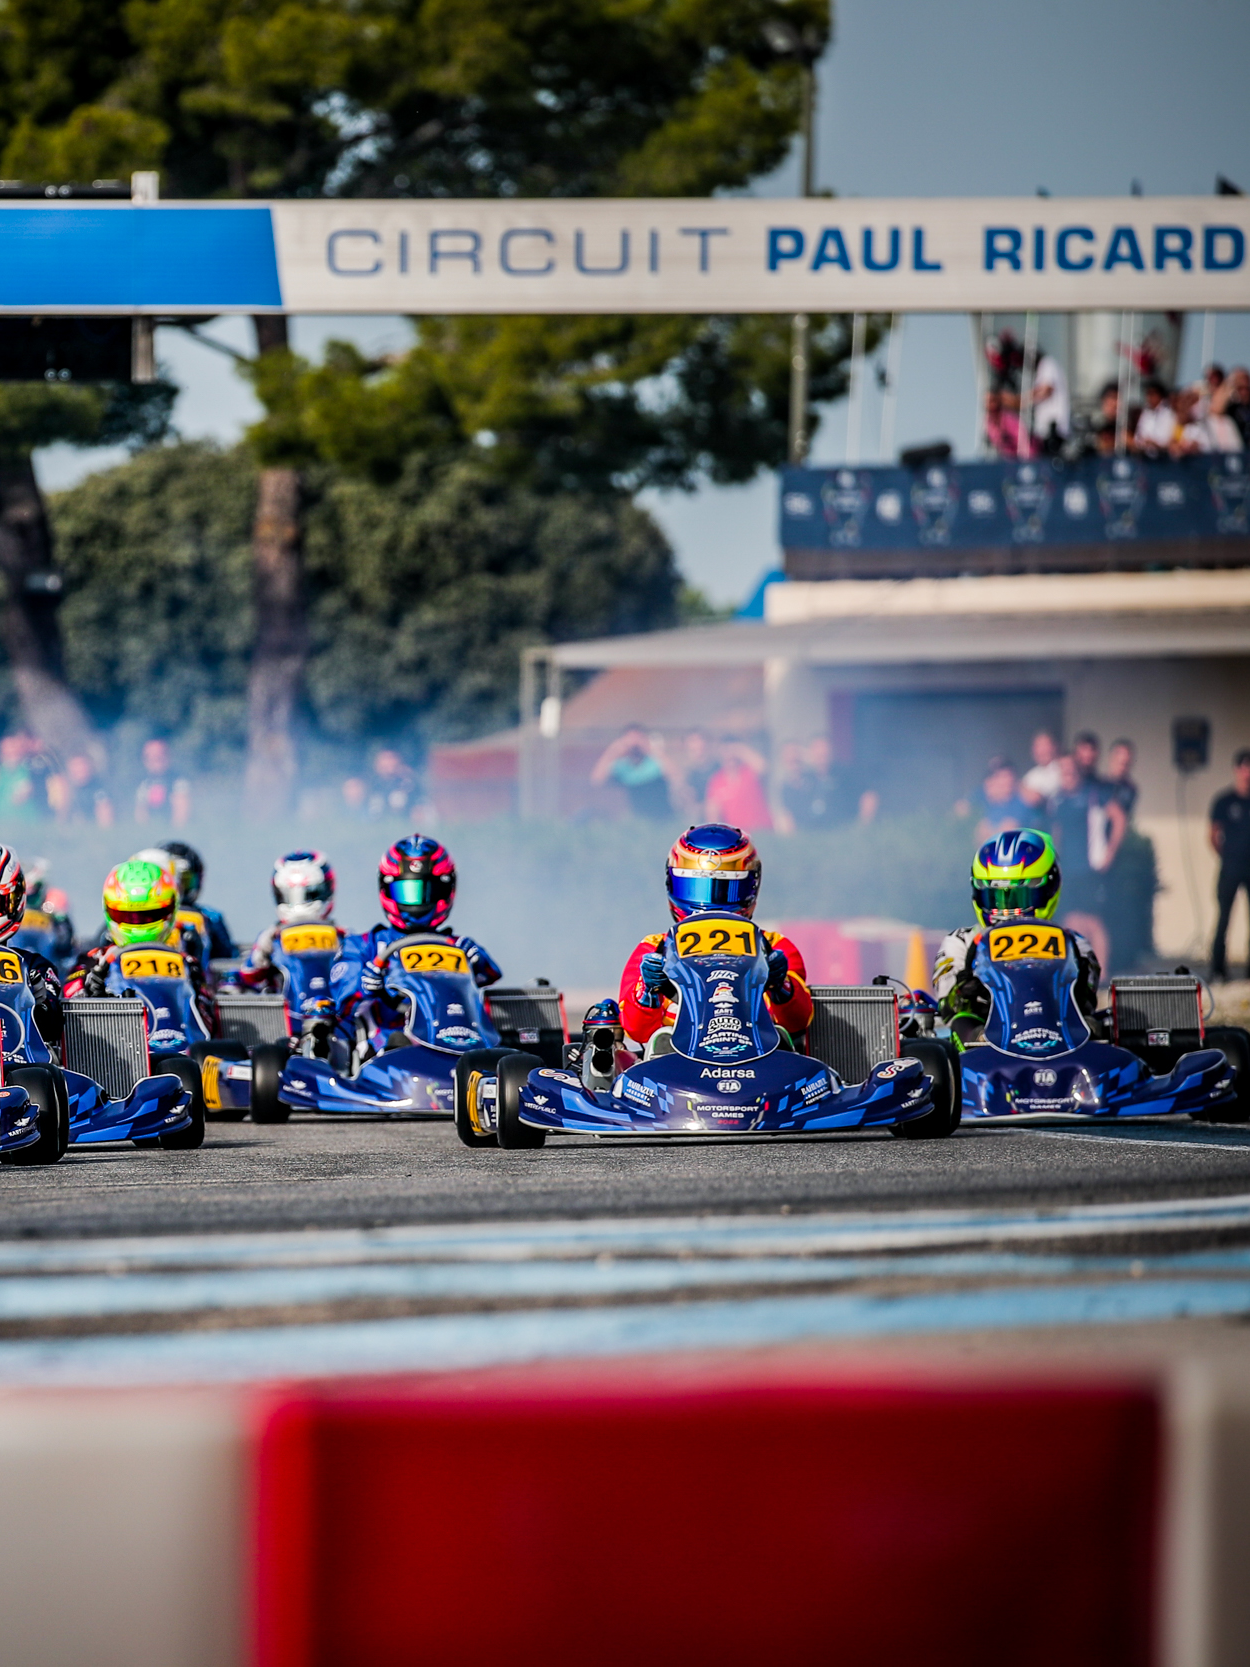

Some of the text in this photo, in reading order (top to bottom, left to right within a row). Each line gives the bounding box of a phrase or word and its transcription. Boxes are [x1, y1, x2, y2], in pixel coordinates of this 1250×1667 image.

[327, 226, 1246, 278] CIRCUIT PAUL RICARD
[679, 929, 752, 956] 221
[993, 933, 1063, 959] 224
[406, 952, 462, 971] 227
[126, 959, 181, 977] 218
[710, 1017, 740, 1026] AUTO
[699, 1037, 738, 1047] SPRINT
[703, 1032, 750, 1041] KARTING
[700, 1068, 755, 1079] Adarsa
[1034, 1073, 1055, 1083] FIA
[718, 1081, 740, 1091] FIA
